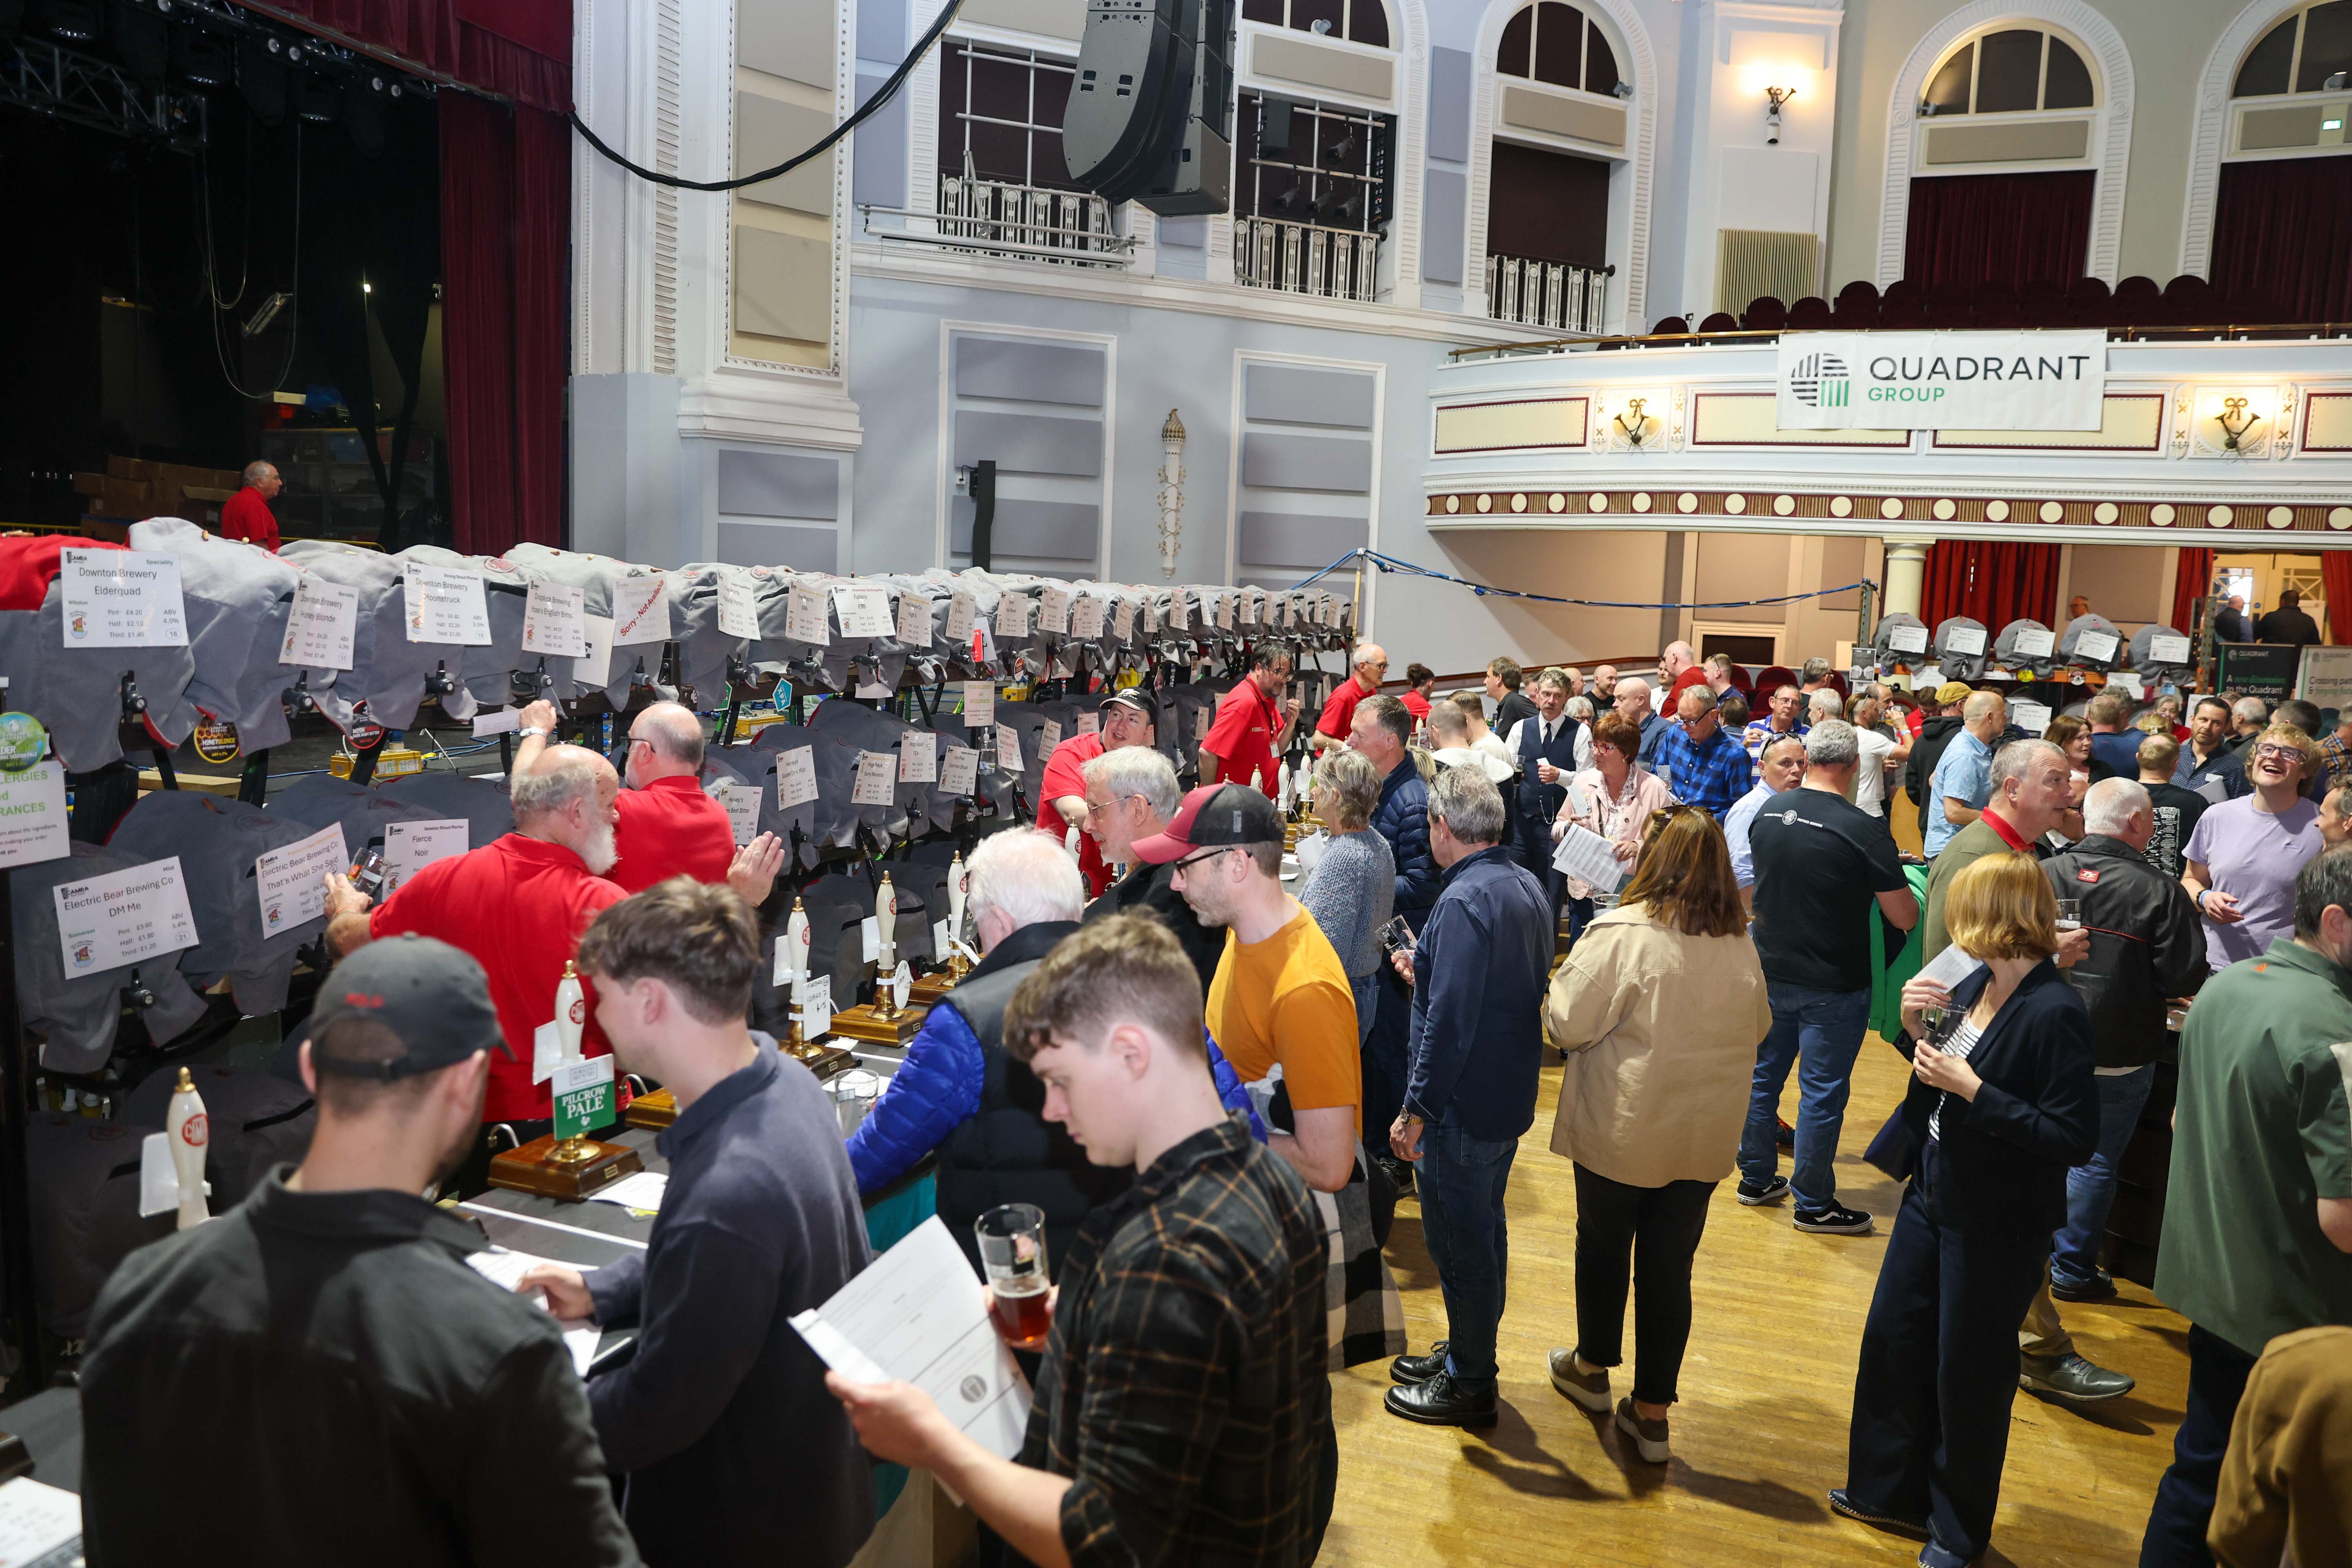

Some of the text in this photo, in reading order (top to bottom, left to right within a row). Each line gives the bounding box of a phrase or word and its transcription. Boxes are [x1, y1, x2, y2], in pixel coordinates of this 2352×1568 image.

[1870, 356, 2090, 380] QUADRANT
[1868, 387, 1945, 402] GROUP
[80, 568, 157, 579] Downton Brewery
[416, 578, 468, 592] Downton Brewery
[95, 586, 140, 596] Elderquad
[301, 595, 343, 609] Downton Brewery
[424, 594, 461, 603] Moonstruck
[535, 593, 571, 607] Dropkick Brewing
[532, 606, 543, 614] Rose's
[544, 608, 559, 617] English
[621, 579, 664, 636] Sorry Not Available
[301, 611, 336, 622] Honey Blonde
[2226, 675, 2232, 683] A
[2309, 677, 2337, 686] Crossing
[2249, 686, 2283, 694] Quadrant
[262, 841, 339, 878] Electric Bear Brewing Co
[267, 856, 338, 891] That's What She Said
[65, 895, 101, 911] Electric
[103, 889, 124, 901] Bear
[126, 880, 160, 895] Brewing
[66, 886, 89, 895] CAMRA
[109, 902, 142, 917] DM Me
[137, 922, 152, 931] £3.60
[172, 920, 187, 929] 3.4%
[68, 929, 96, 938] Somerset
[139, 932, 155, 941] £1.80
[122, 943, 156, 957] Third: £1.20
[807, 992, 821, 1002] IDAHO
[562, 1085, 607, 1107] PILCROW
[567, 1096, 604, 1119] PALE
